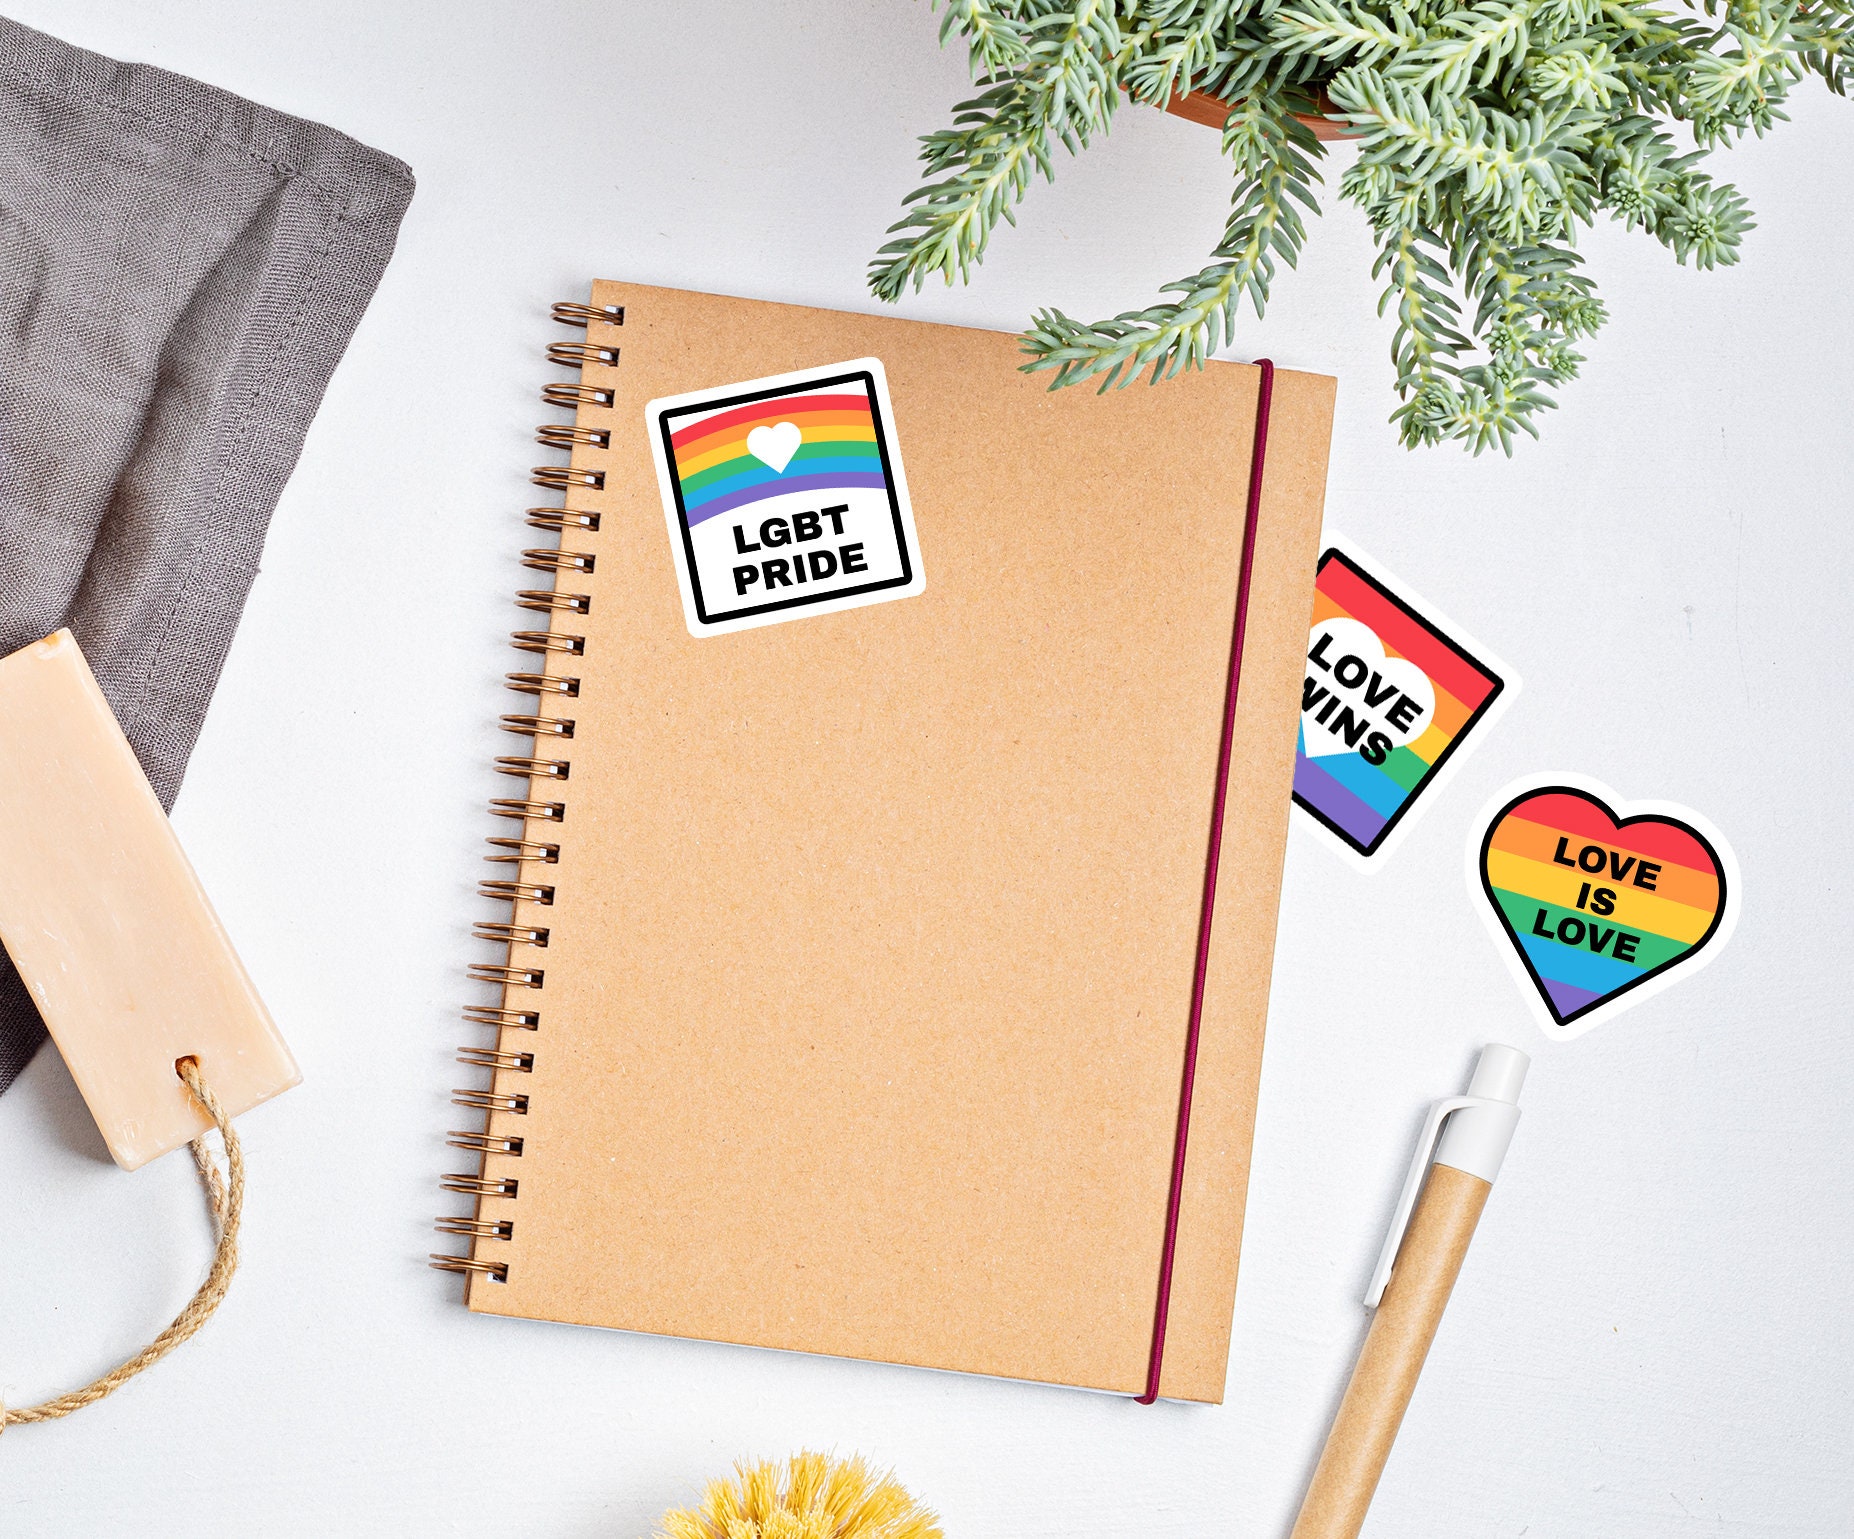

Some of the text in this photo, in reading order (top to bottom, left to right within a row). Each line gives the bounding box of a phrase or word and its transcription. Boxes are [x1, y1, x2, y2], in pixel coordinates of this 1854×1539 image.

[732, 503, 849, 555] LGBT
[732, 542, 869, 596] PRIDE
[1307, 632, 1424, 735] LOVE
[1553, 836, 1662, 891] LOVE
[1575, 882, 1617, 916] IS
[1532, 908, 1641, 963] LOVE
